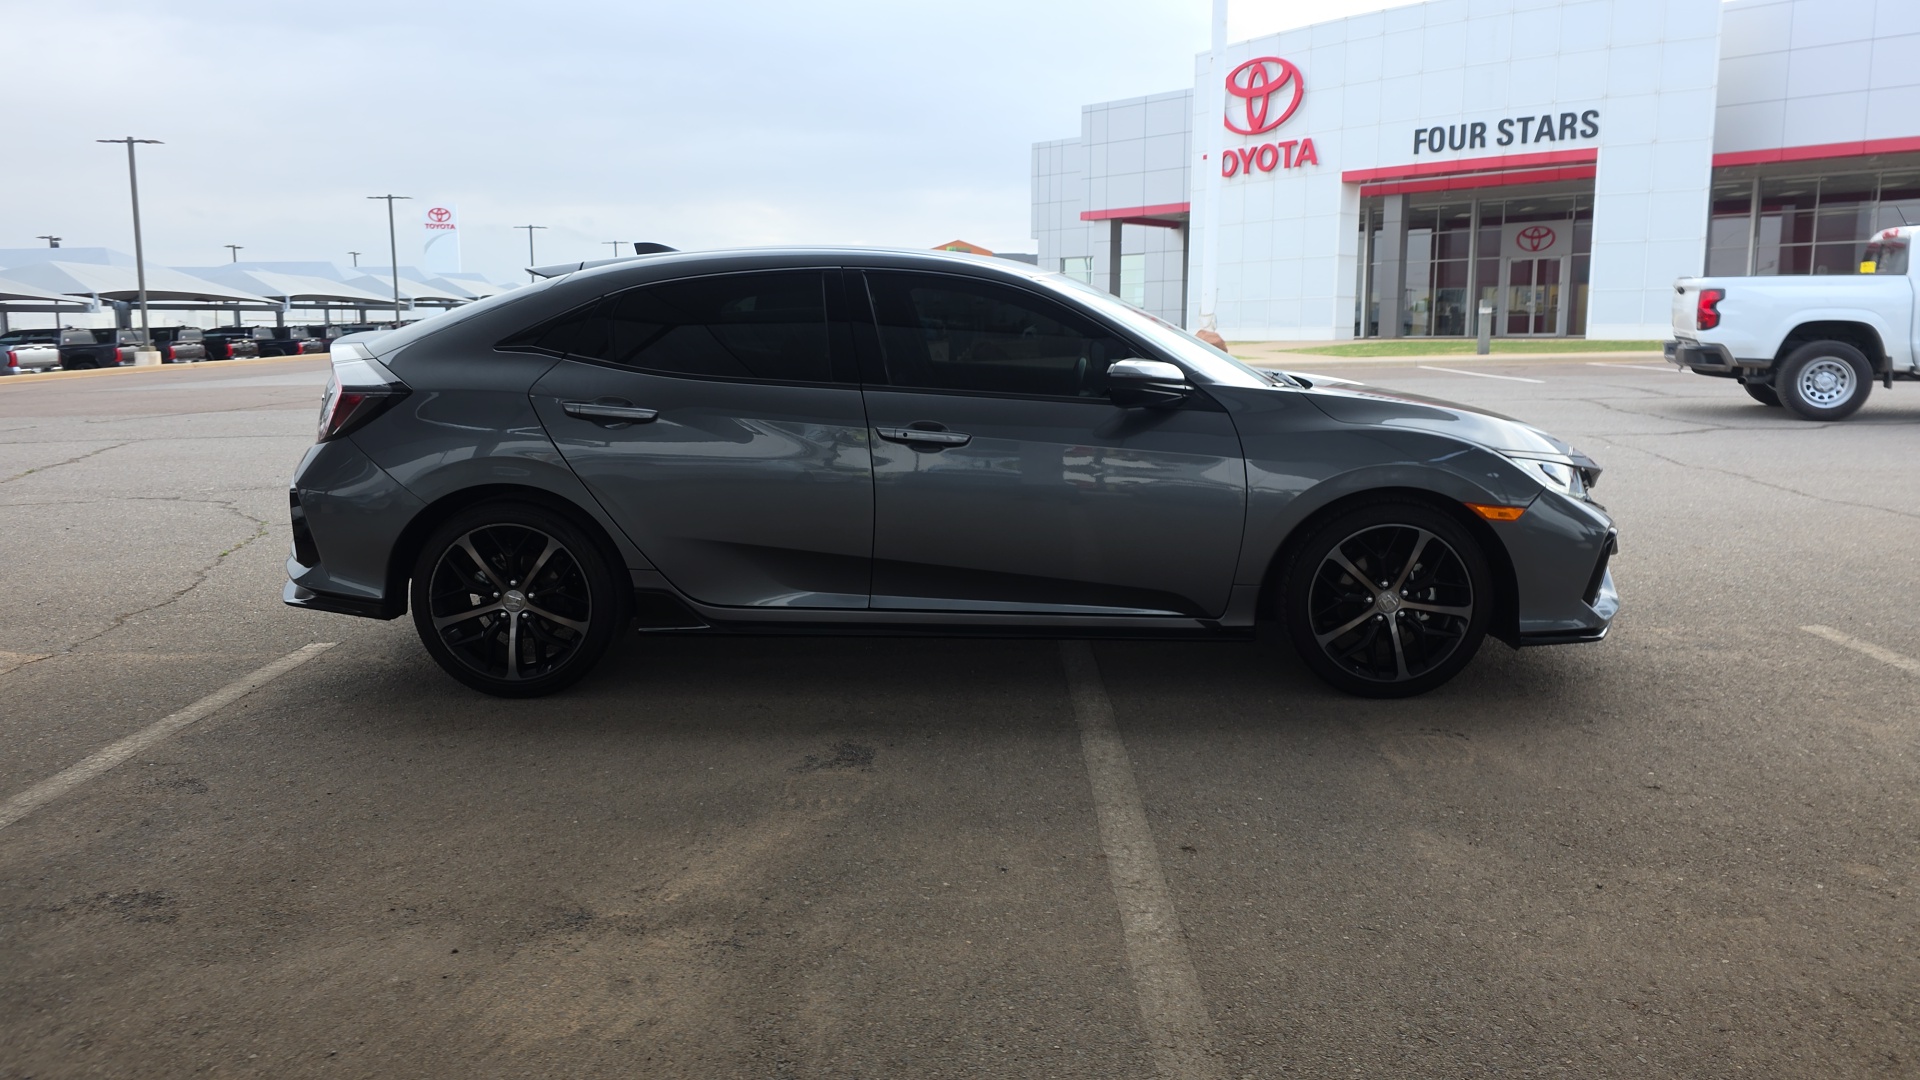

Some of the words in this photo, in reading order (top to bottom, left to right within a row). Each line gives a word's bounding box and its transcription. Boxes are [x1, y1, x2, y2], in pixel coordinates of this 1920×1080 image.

[1413, 122, 1487, 154] FOUR
[1496, 109, 1600, 146] STARS
[1203, 138, 1318, 178] OYOTA
